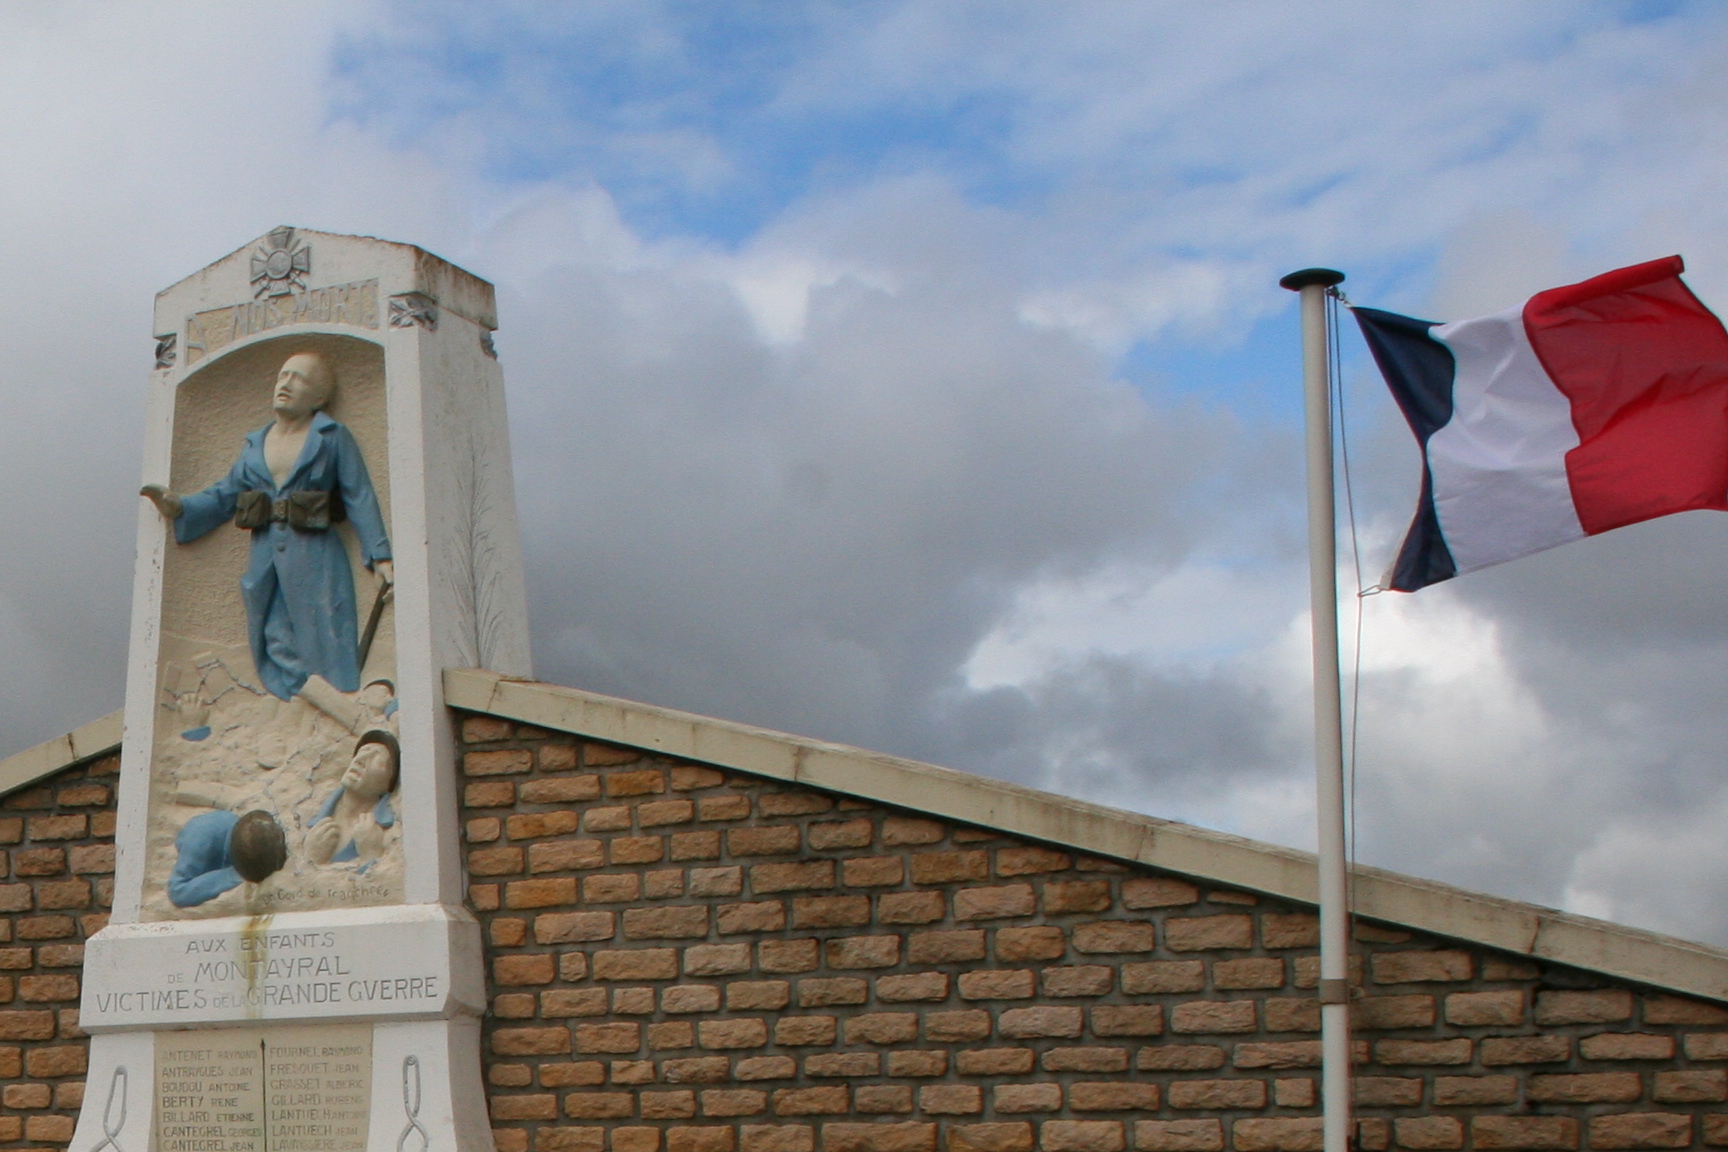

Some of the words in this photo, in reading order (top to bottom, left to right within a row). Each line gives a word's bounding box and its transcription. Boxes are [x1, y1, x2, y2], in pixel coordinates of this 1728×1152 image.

[229, 298, 284, 341] NOS
[291, 278, 379, 329] MORTS
[239, 931, 335, 951] ENFANTS
[167, 973, 183, 985] DE
[194, 955, 351, 983] MONTAYRAL
[96, 988, 208, 1013] VICTIMES
[246, 982, 342, 1006] GRANDE
[229, 1067, 253, 1077] JEAN
[162, 1096, 204, 1108] BERTY
[229, 1141, 254, 1151] JEAN
